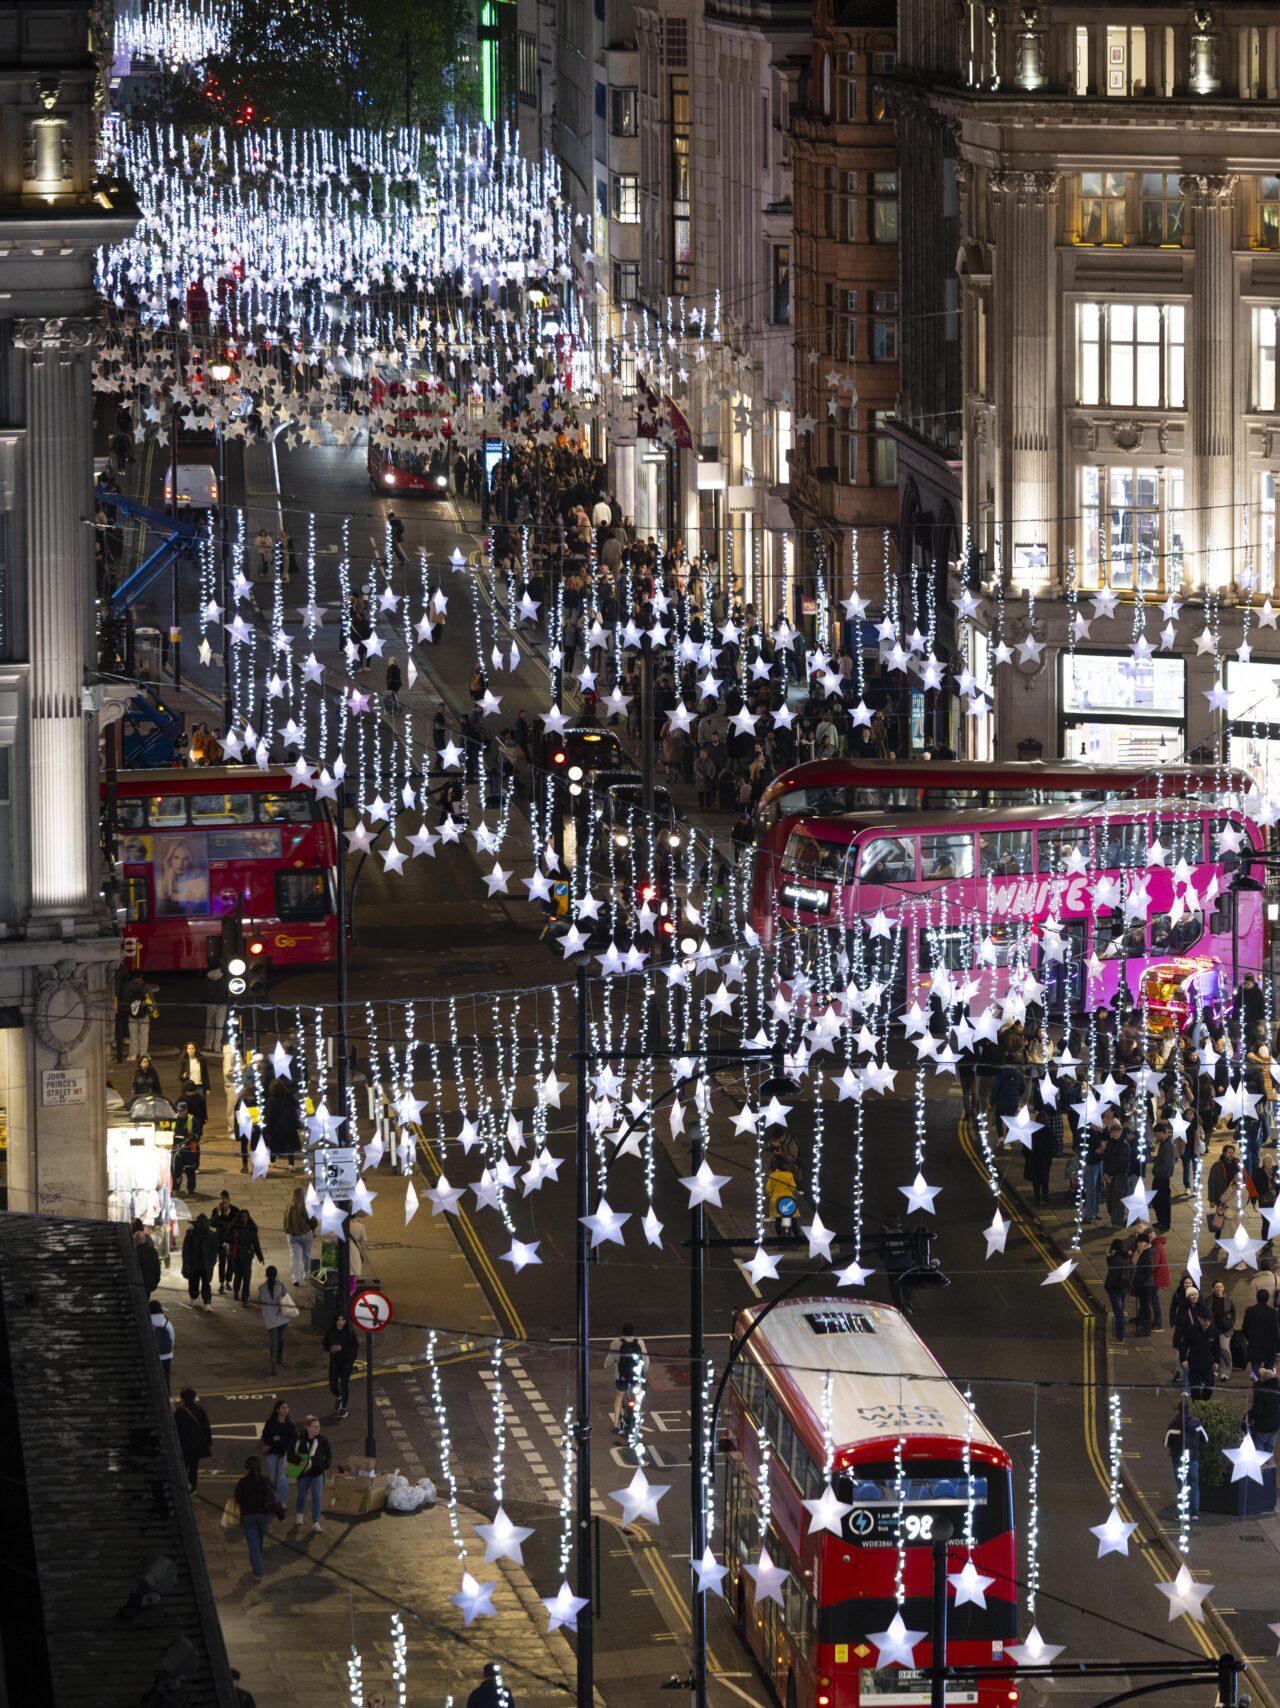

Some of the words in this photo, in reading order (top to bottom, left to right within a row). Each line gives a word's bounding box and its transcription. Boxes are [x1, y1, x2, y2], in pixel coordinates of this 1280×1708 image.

[47, 1072, 66, 1081] JOHN
[46, 1088, 71, 1098] STREET
[905, 1515, 934, 1540] 98
